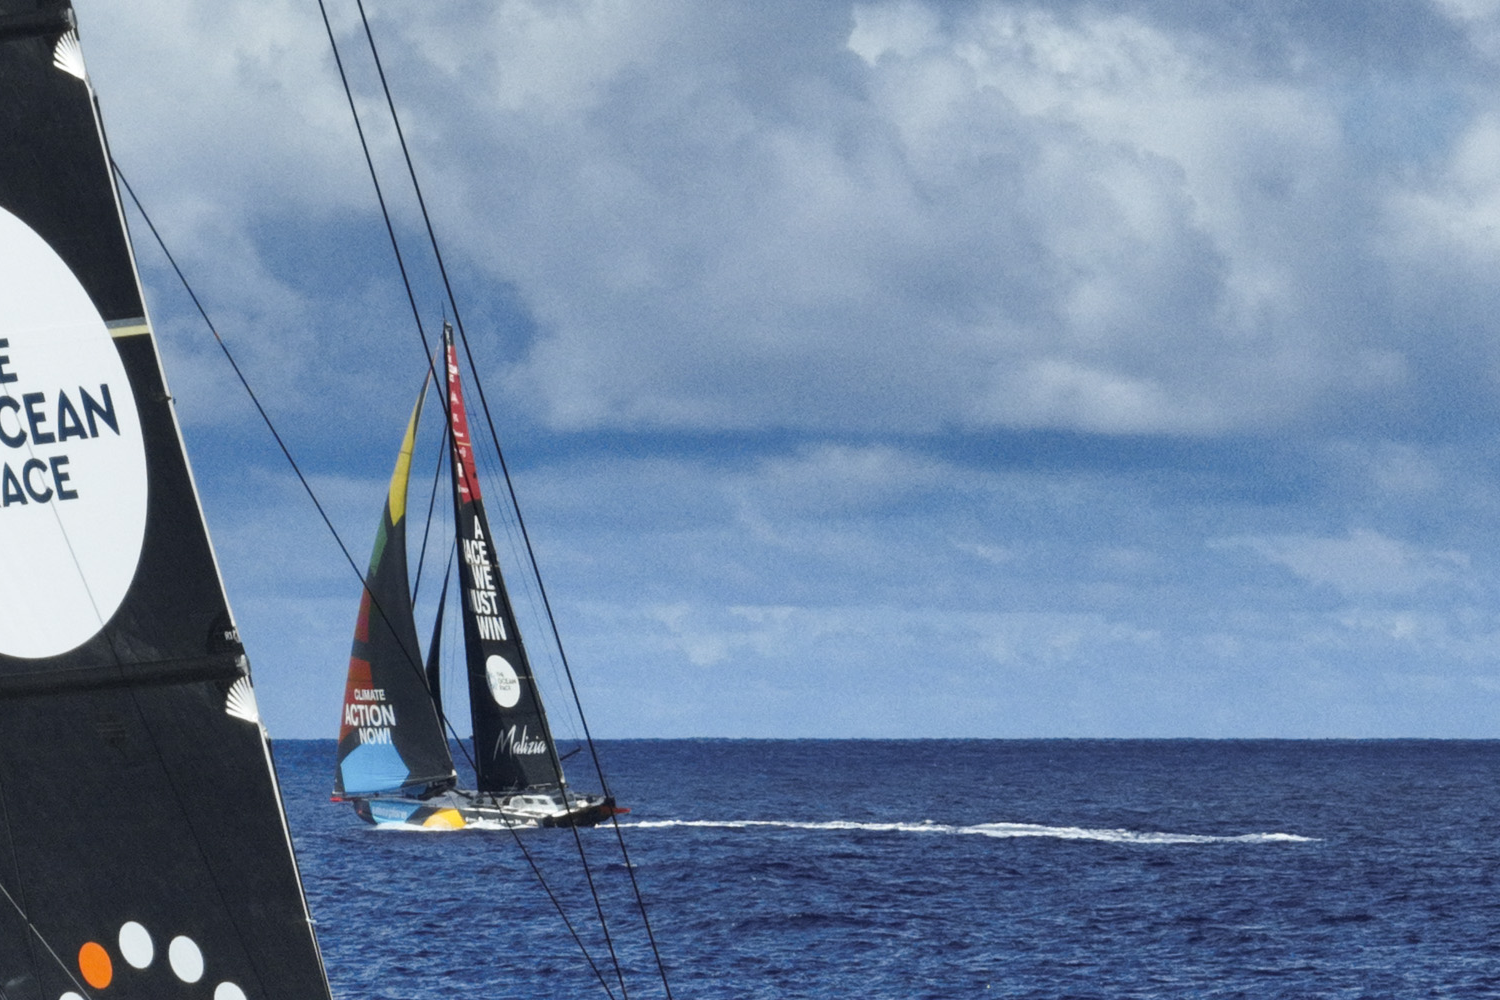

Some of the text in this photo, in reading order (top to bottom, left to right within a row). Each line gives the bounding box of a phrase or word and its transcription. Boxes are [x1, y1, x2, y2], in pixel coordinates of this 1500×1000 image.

[474, 515, 484, 540] A
[463, 538, 489, 565] ACE
[471, 564, 495, 590] WE
[476, 615, 507, 641] WIN
[354, 689, 386, 701] CLIMATE
[345, 704, 396, 726] ACTION
[359, 727, 393, 745] NOW!
[493, 724, 547, 761] Malizia
